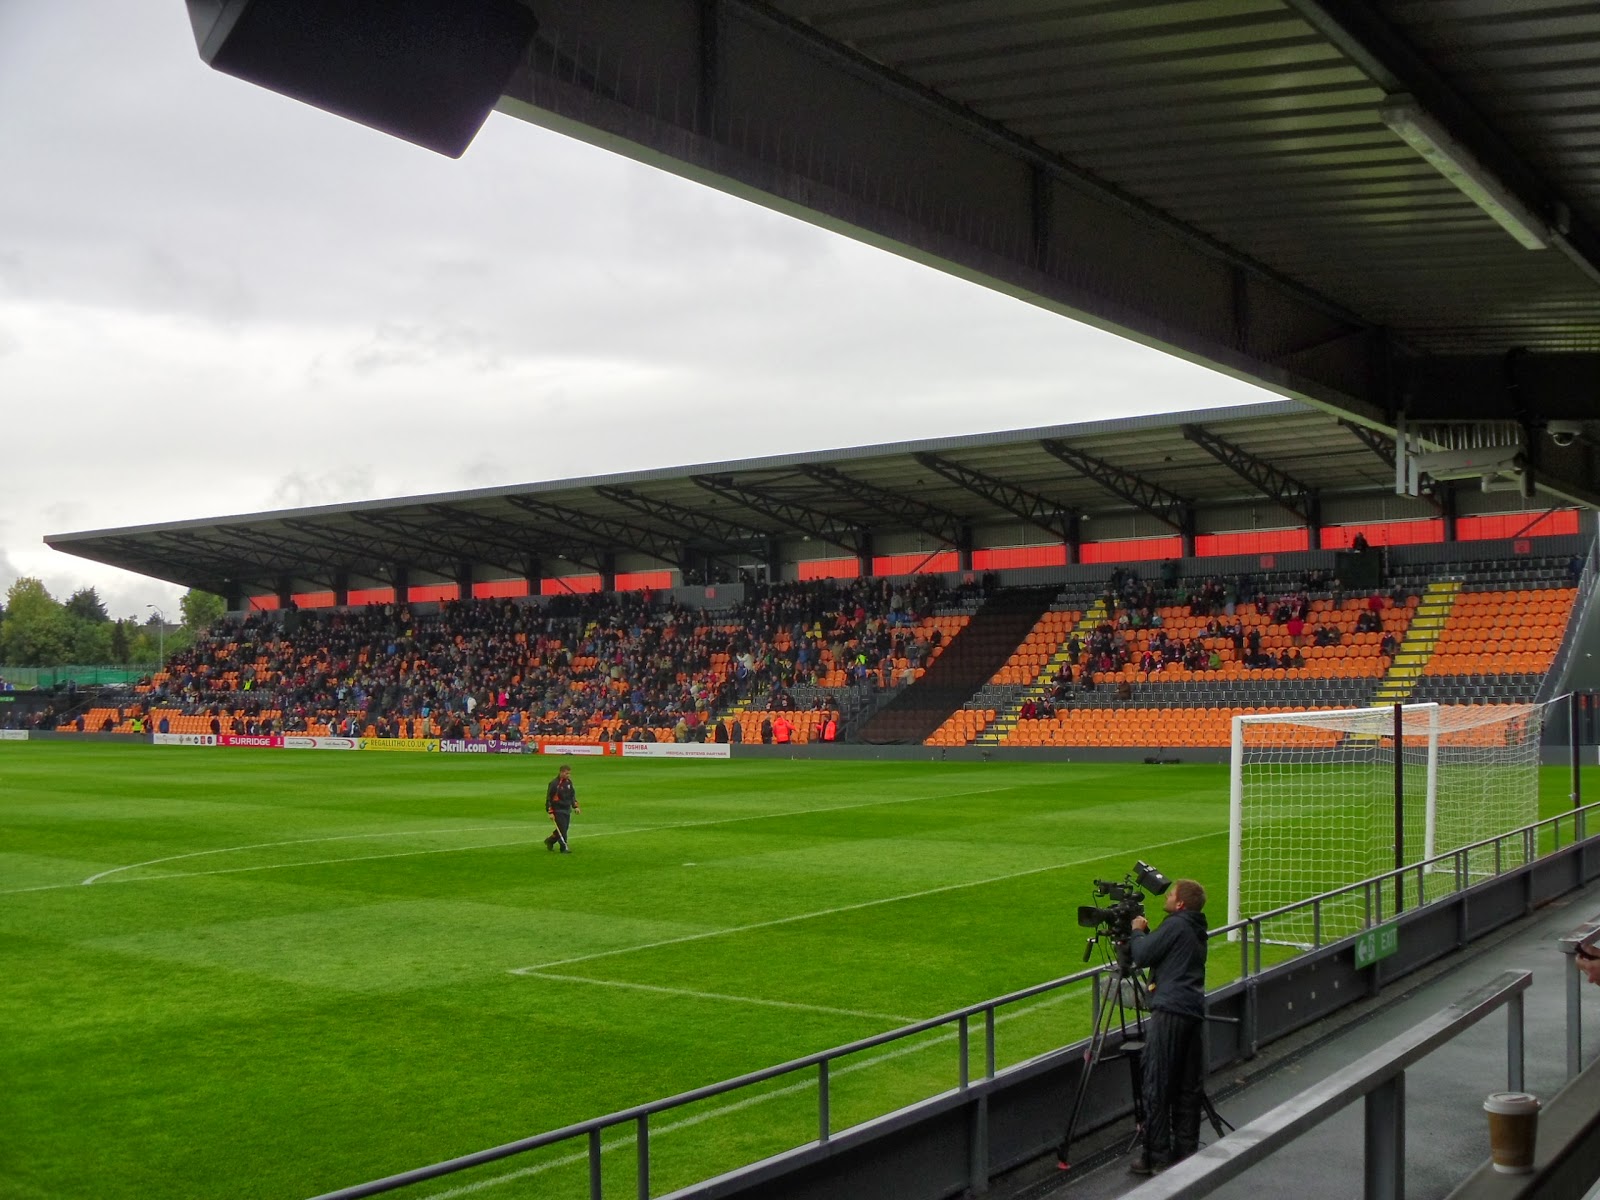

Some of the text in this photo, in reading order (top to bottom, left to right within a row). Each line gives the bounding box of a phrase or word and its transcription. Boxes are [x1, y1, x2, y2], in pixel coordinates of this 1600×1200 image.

[229, 737, 271, 746] SURRIDGE
[370, 739, 426, 748] REGALLITHO.CO.UK
[440, 740, 488, 753] Skrill.com
